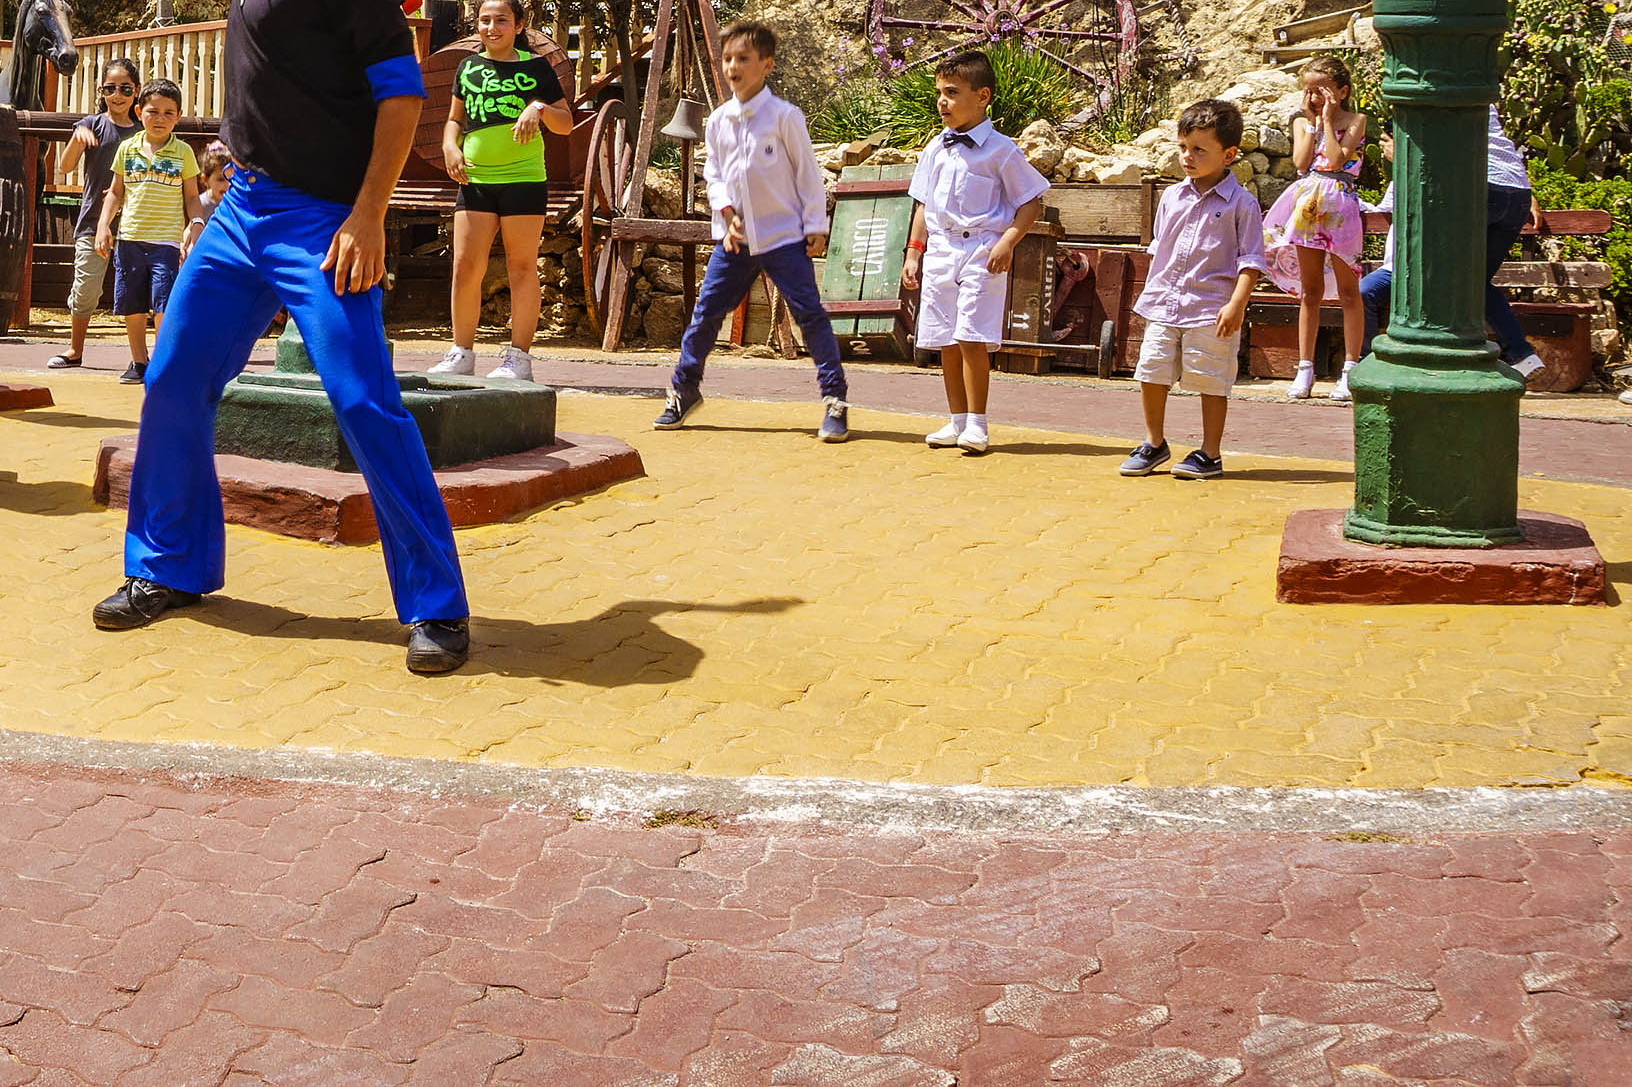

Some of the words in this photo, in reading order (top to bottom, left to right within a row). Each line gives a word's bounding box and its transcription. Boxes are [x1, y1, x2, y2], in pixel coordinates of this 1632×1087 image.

[460, 60, 517, 96] Kiss
[465, 94, 498, 123] Me
[850, 218, 889, 277] CARGO
[1043, 256, 1055, 327] CARGO
